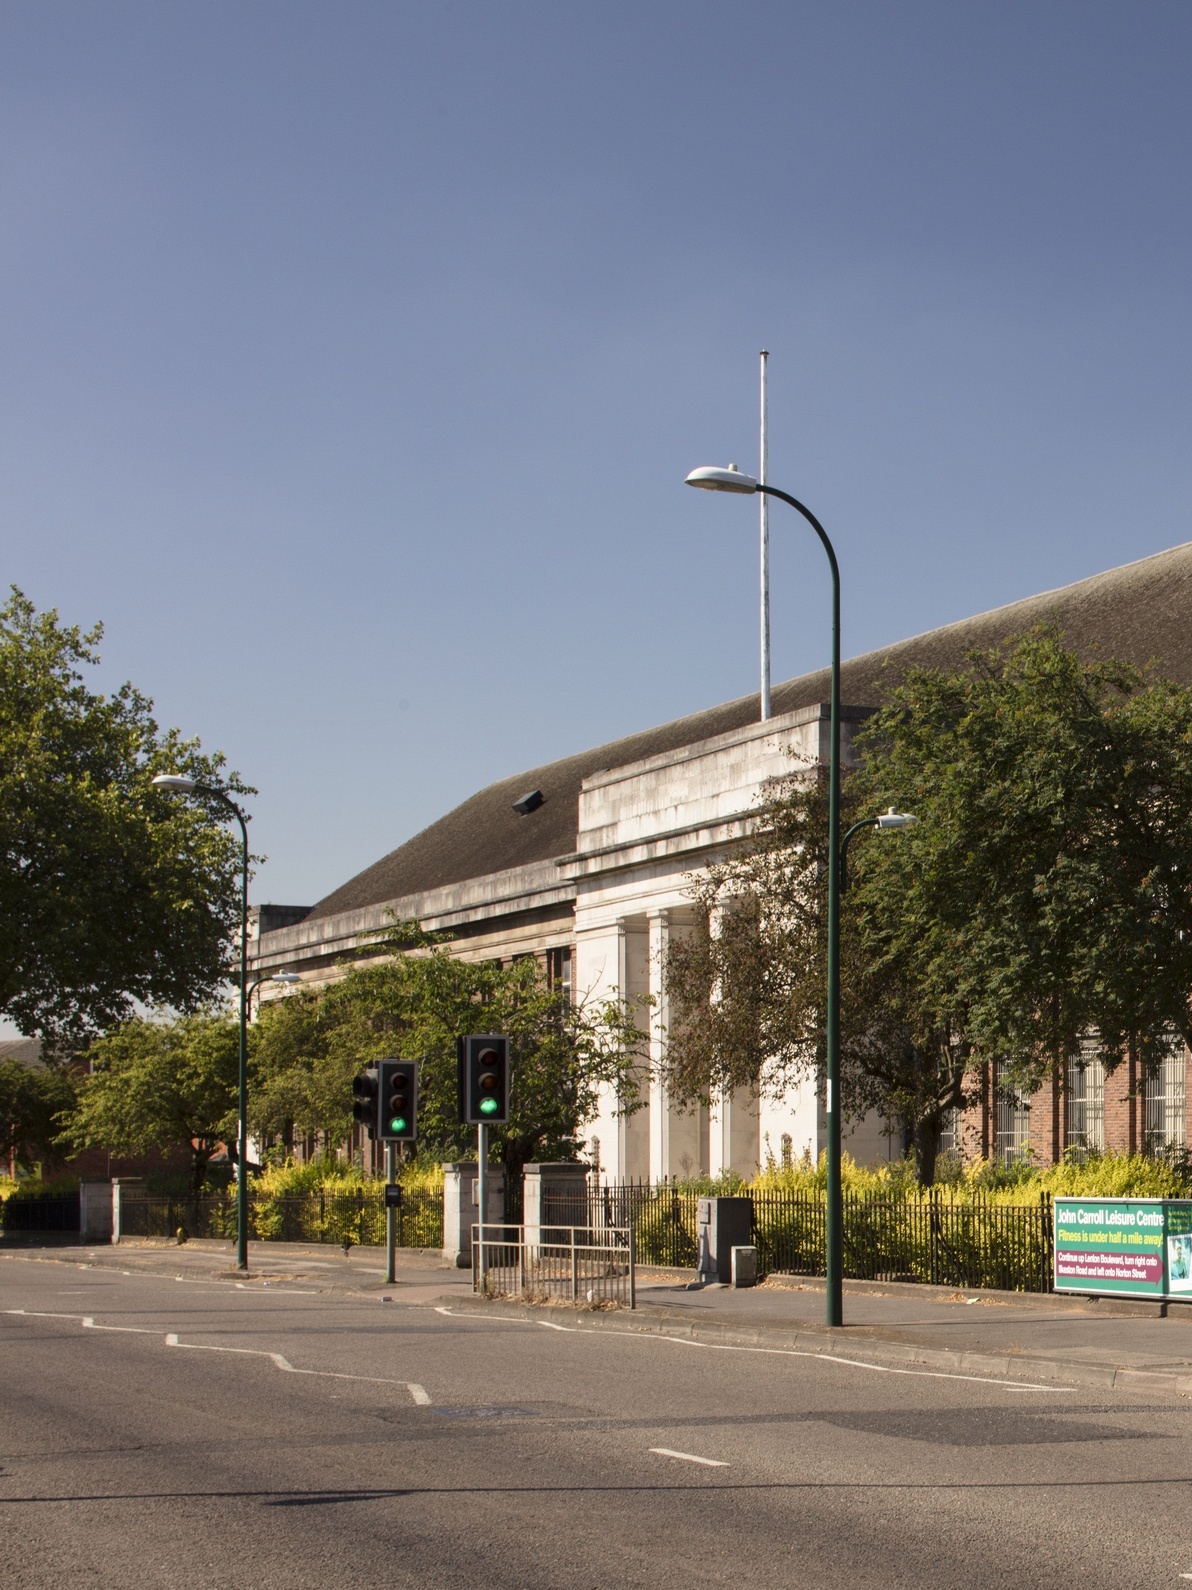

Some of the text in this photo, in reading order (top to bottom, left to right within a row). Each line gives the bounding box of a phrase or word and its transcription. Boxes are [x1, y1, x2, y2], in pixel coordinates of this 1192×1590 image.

[1058, 1209, 1076, 1224] John
[1077, 1209, 1104, 1225] Carroll
[1105, 1210, 1135, 1226] Leisure
[1137, 1210, 1165, 1227] Centre
[1058, 1229, 1163, 1248] Fitness is under half a mile away!
[1058, 1252, 1157, 1267] Continue up Lenton Boulevard, turn right onto
[1076, 1266, 1087, 1275] Road
[1088, 1266, 1096, 1276] and
[1105, 1268, 1115, 1277] onto
[1116, 1268, 1131, 1277] Norton
[1132, 1269, 1147, 1279] Street
